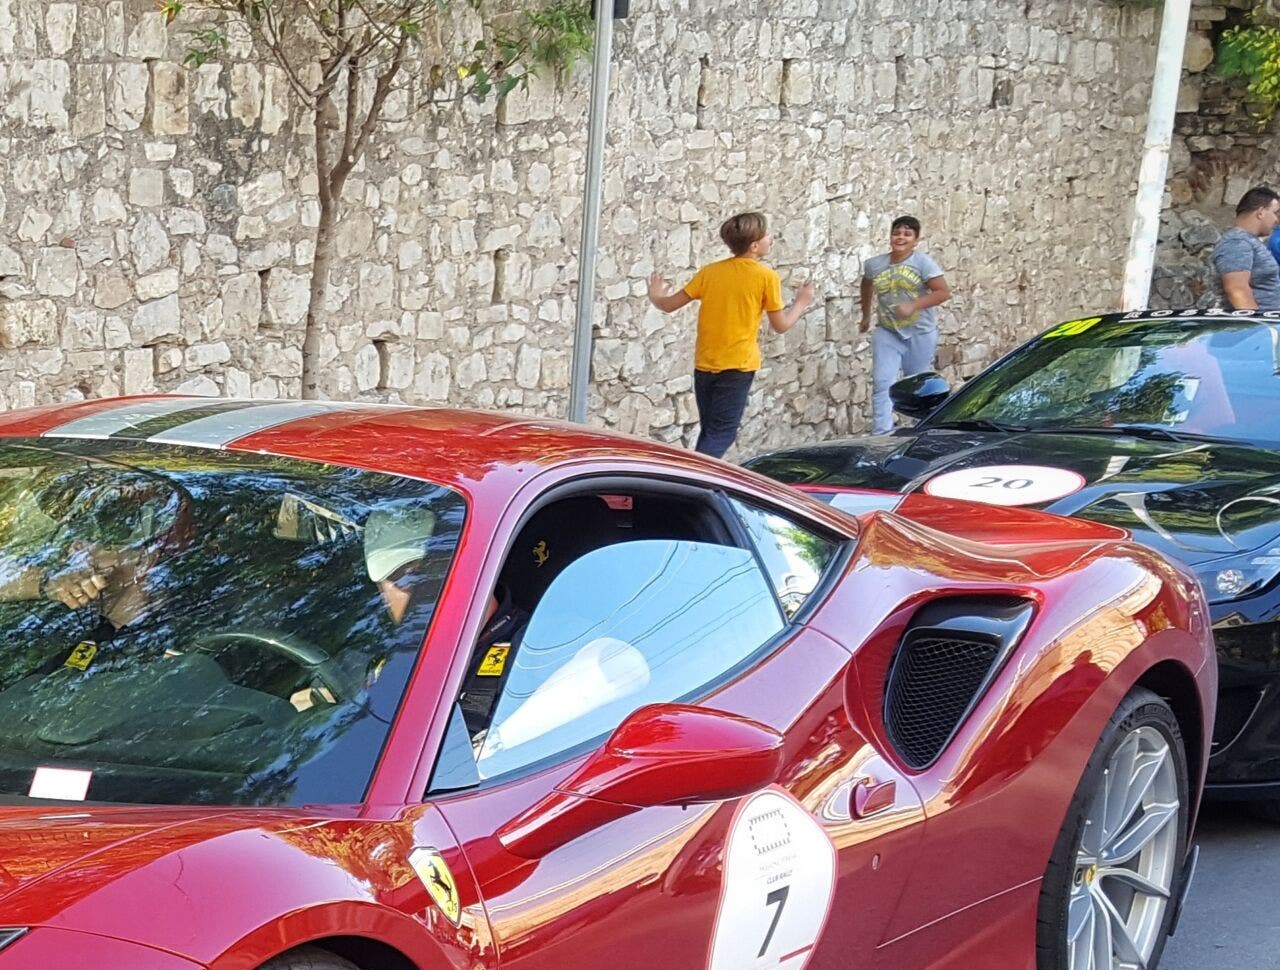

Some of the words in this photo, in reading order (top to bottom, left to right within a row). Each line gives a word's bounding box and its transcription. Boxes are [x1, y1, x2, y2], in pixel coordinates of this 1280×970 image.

[1042, 317, 1103, 339] 20
[969, 475, 1034, 490] 20
[756, 885, 790, 959] 7
